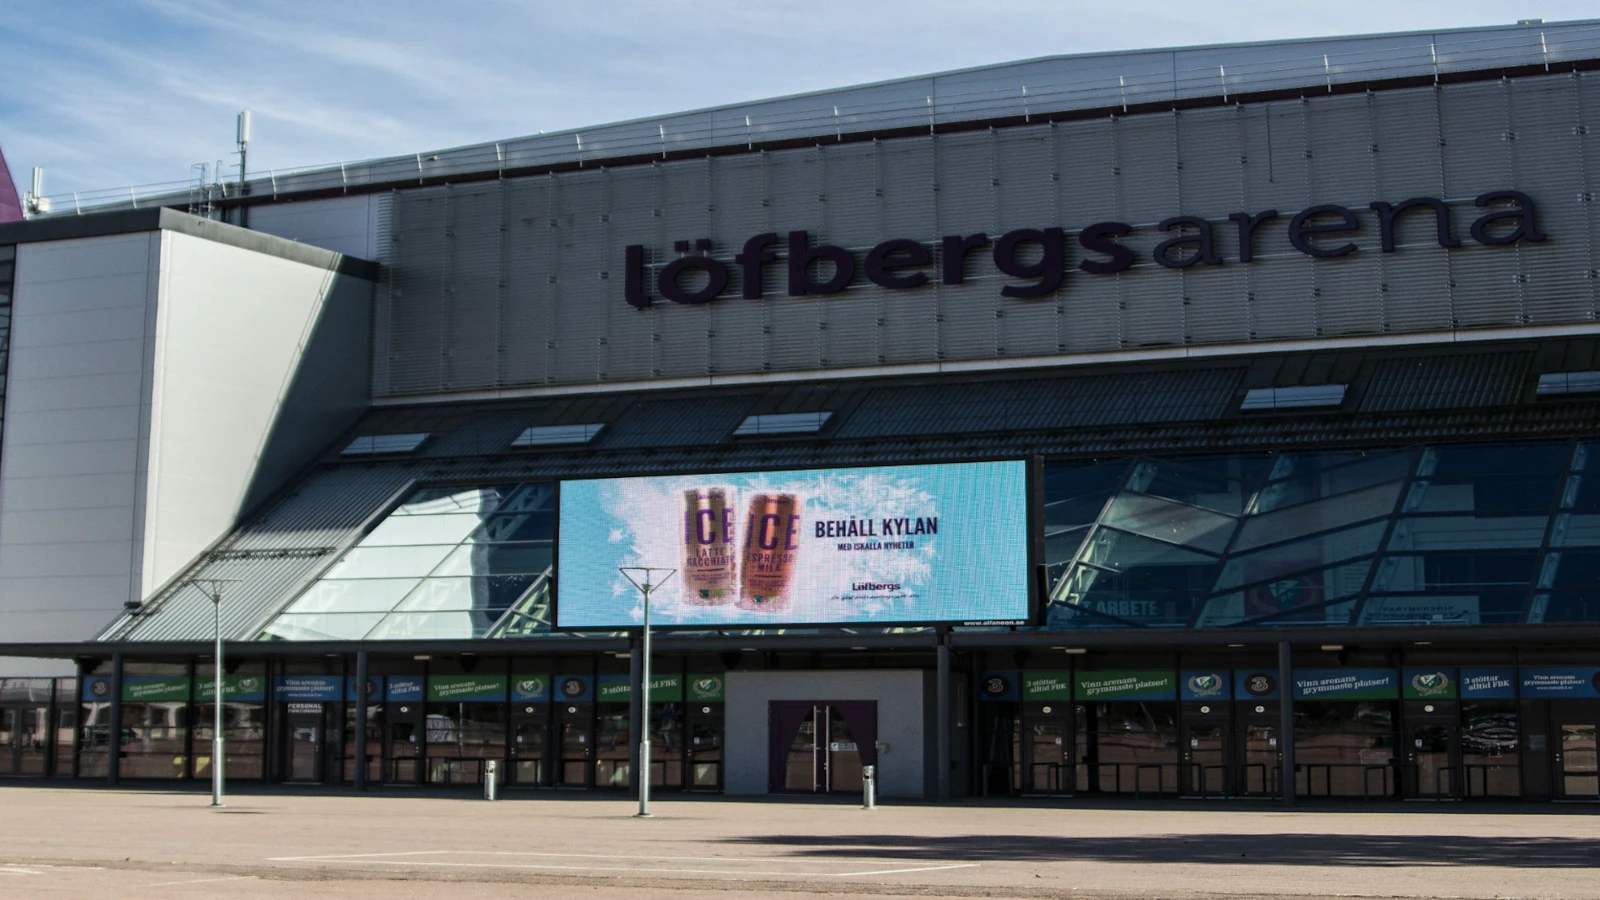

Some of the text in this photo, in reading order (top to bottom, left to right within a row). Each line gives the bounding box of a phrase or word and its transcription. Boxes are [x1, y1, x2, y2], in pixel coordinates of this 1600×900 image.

[684, 508, 735, 545] ICE
[745, 514, 800, 550] ICE
[815, 515, 938, 538] BEHÅLL KYLAN
[837, 541, 914, 551] MED ISKALLA NYHETER
[696, 547, 725, 557] LATTE
[852, 582, 900, 592] Löfbergs
[1096, 600, 1158, 616] ARBETE
[450, 681, 475, 689] arenans
[660, 679, 677, 689] FBK
[1032, 678, 1057, 687] stöttar
[1081, 677, 1137, 689] Vinn arenans
[1297, 676, 1357, 688] Vinn arenans
[1464, 675, 1499, 685] 3 stöttar
[1468, 680, 1510, 691] alltid FBK
[439, 683, 499, 697] grymmaste platser!
[602, 685, 632, 695] 3 stötta
[1030, 683, 1066, 693] alltid FBK
[1087, 679, 1168, 695] grymmaste platser!
[1303, 677, 1389, 695] grymmaste platser!
